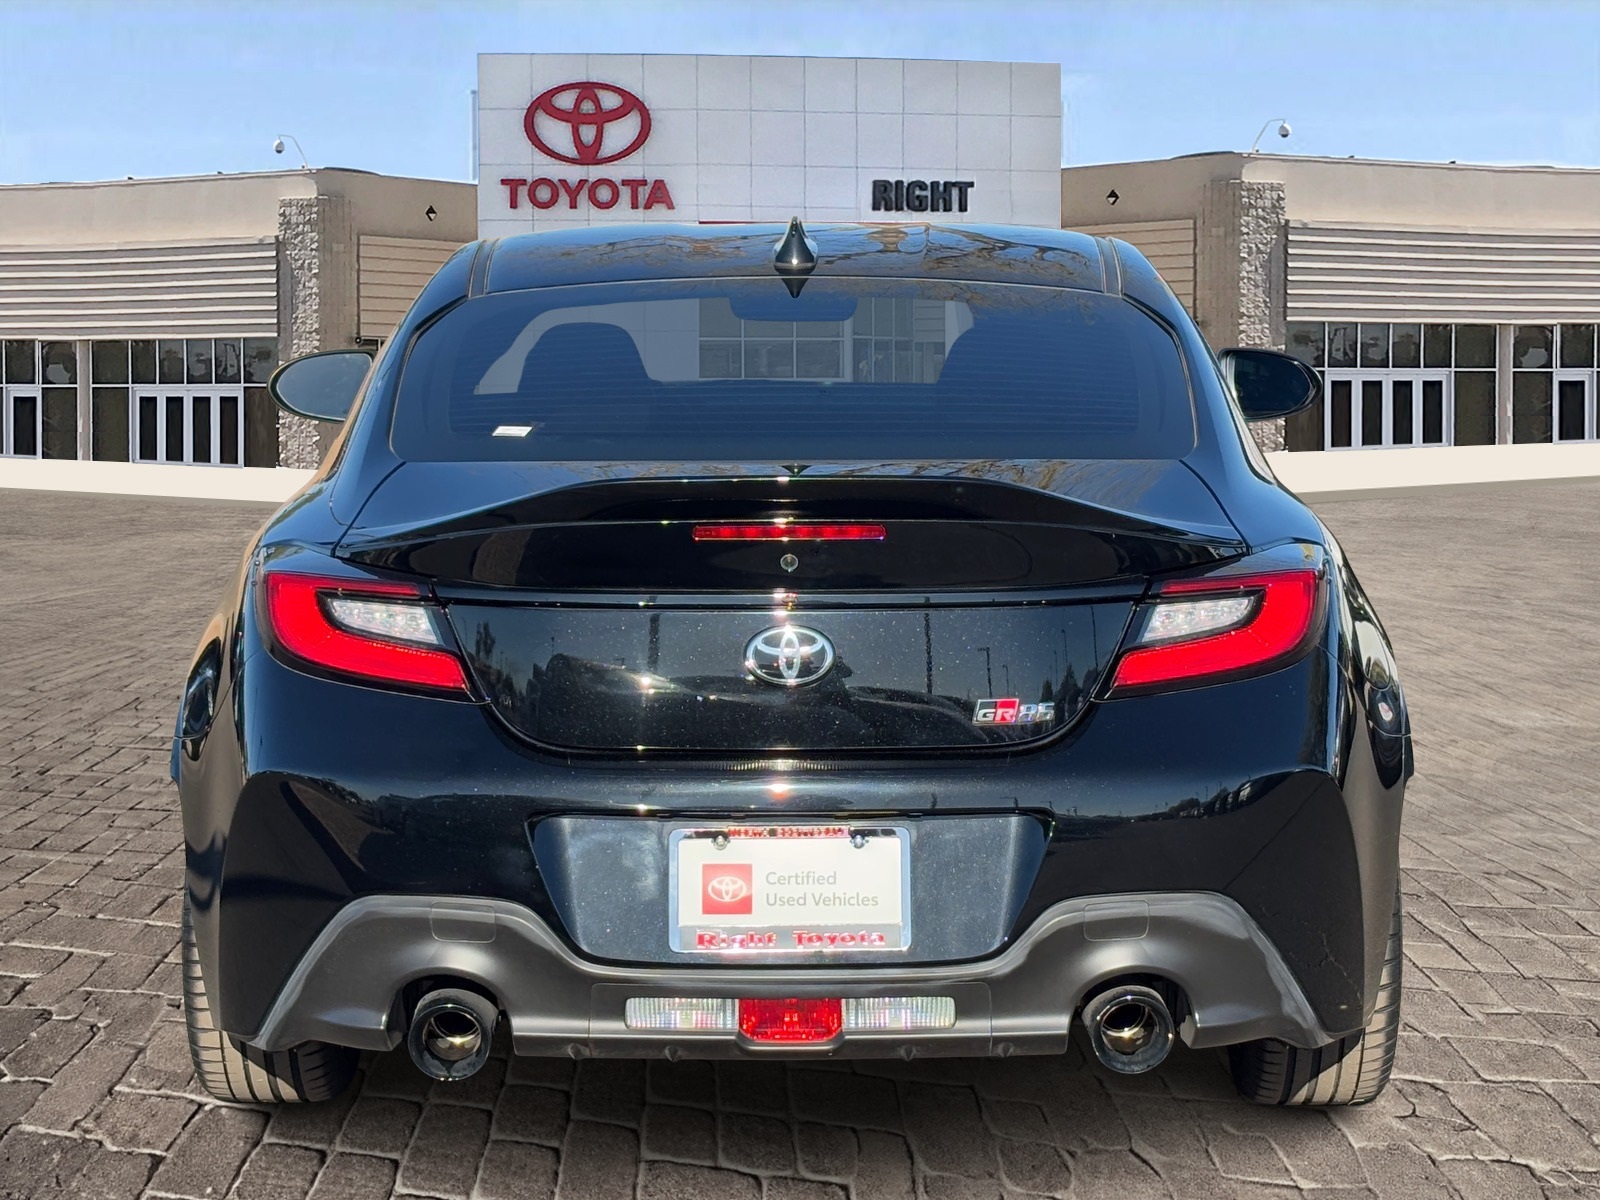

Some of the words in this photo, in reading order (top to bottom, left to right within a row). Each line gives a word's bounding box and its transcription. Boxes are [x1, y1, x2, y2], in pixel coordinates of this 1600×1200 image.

[500, 178, 675, 210] TOYOTA
[872, 179, 975, 213] RIGHT
[765, 870, 837, 886] Certified
[765, 893, 808, 907] Used
[813, 892, 879, 907] Vehicles
[696, 930, 777, 949] Right
[793, 930, 886, 949] Toyota
